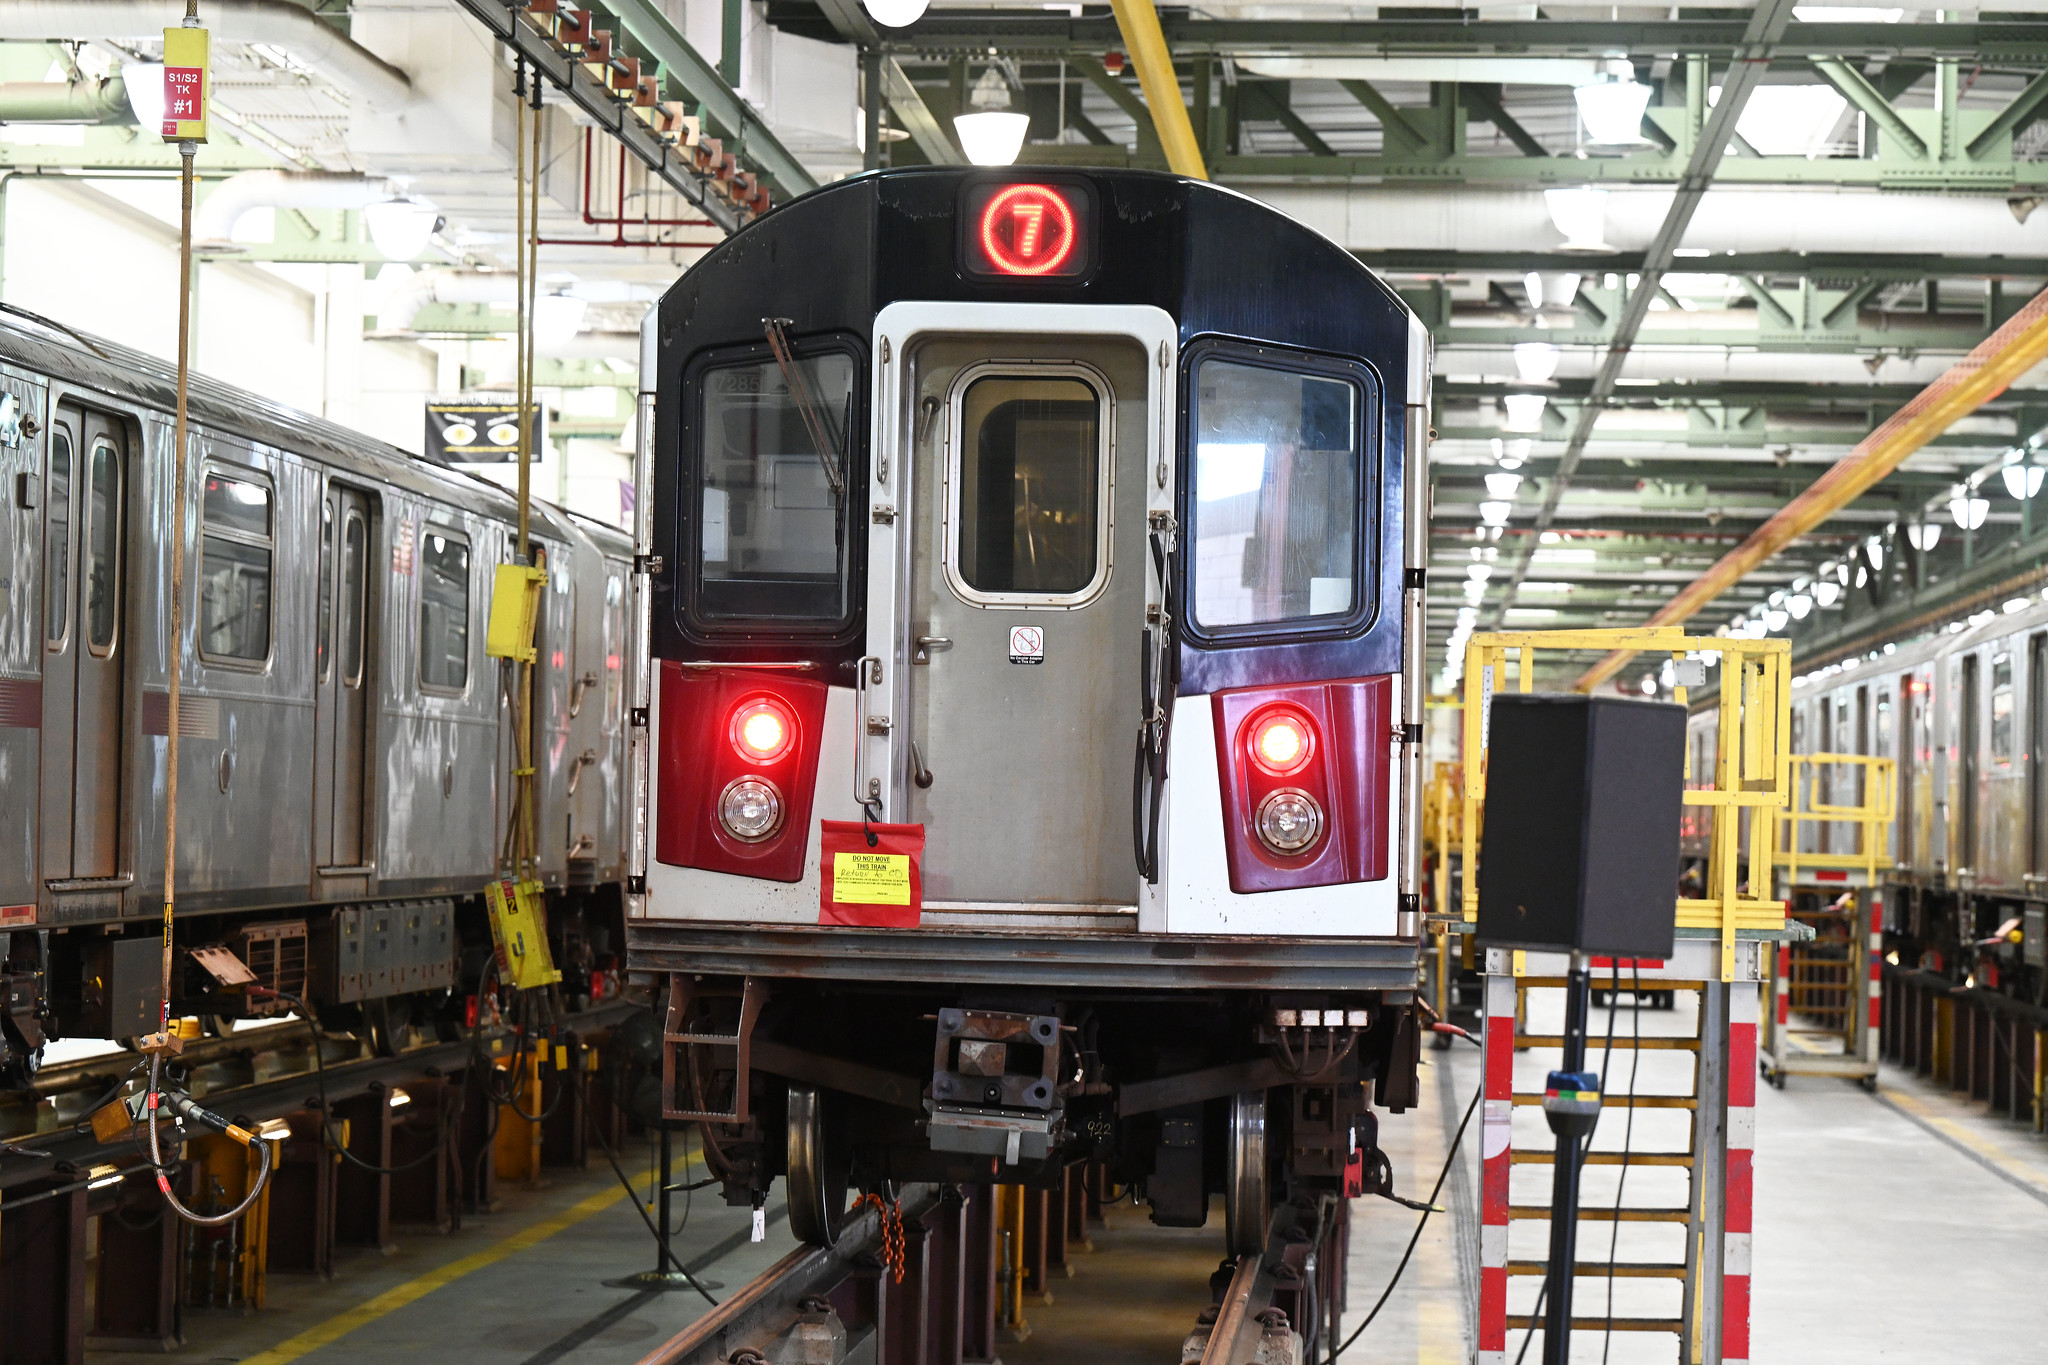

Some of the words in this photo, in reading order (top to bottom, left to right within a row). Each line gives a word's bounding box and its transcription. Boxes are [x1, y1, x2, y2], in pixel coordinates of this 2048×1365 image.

[168, 73, 198, 83] S1/S2
[175, 85, 190, 94] TK
[173, 99, 193, 114] #1
[1013, 203, 1043, 257] 7
[508, 898, 517, 914] 2
